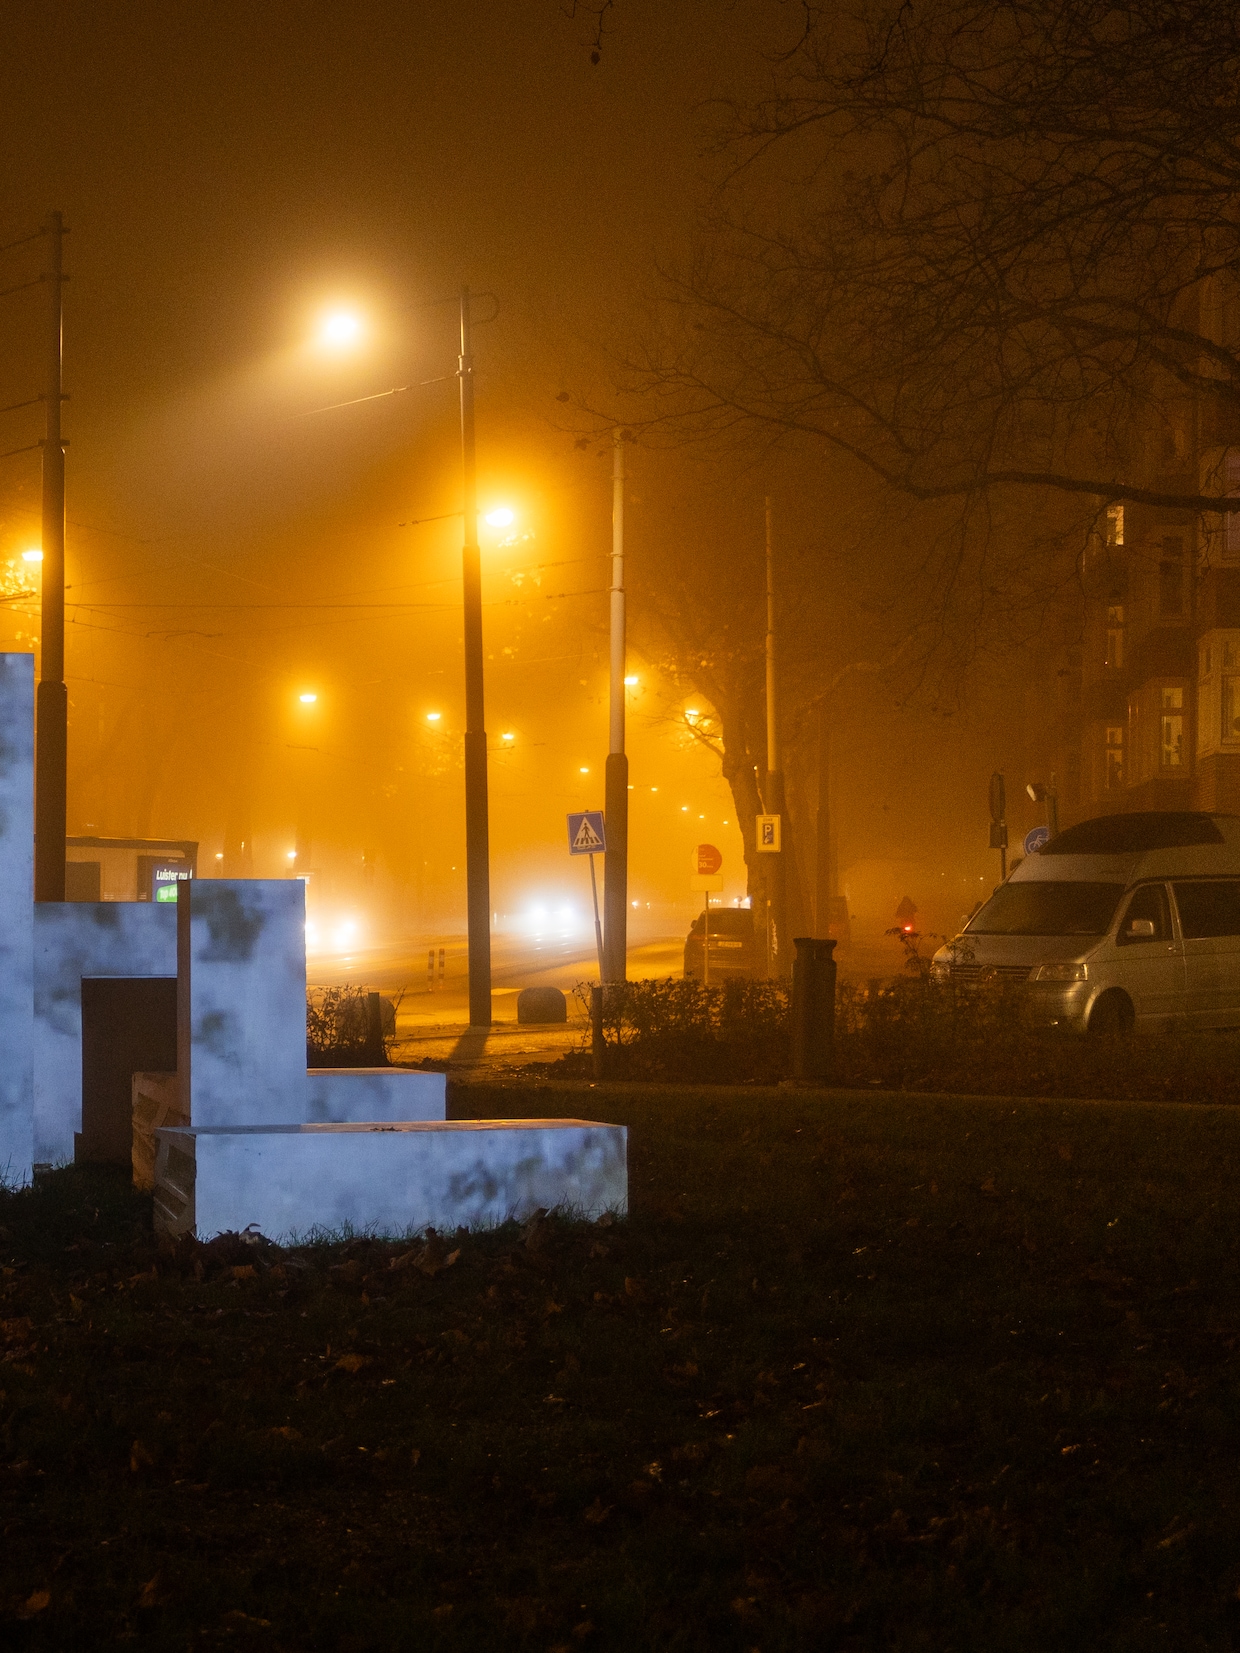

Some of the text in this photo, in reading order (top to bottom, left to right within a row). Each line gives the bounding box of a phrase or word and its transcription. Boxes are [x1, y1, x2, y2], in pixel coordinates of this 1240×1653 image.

[764, 825, 772, 836] P
[156, 868, 178, 881] Luister
[178, 872, 188, 880] nu
